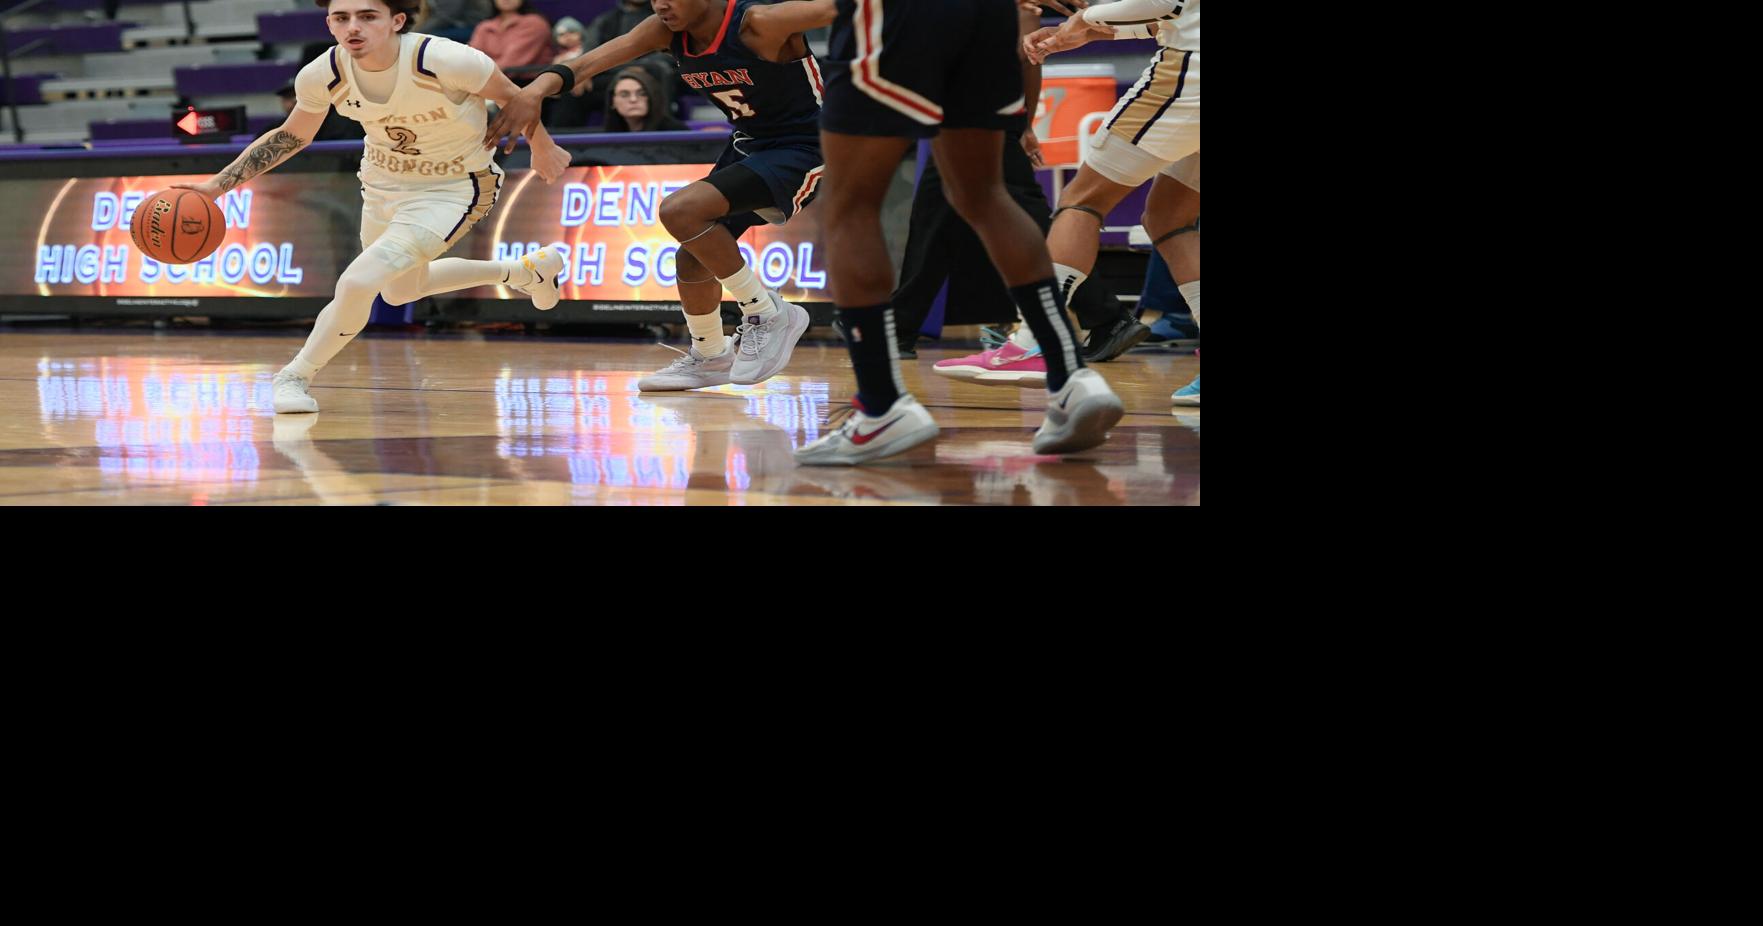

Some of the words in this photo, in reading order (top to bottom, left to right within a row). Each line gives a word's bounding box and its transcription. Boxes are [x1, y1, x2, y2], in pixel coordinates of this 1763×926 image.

[681, 68, 754, 89] RYAN
[711, 88, 757, 121] 5
[385, 126, 421, 156] 2
[91, 187, 254, 231] DEN
[560, 181, 690, 227] DEN
[34, 244, 129, 285] HIGH
[622, 241, 827, 289] SCOL
